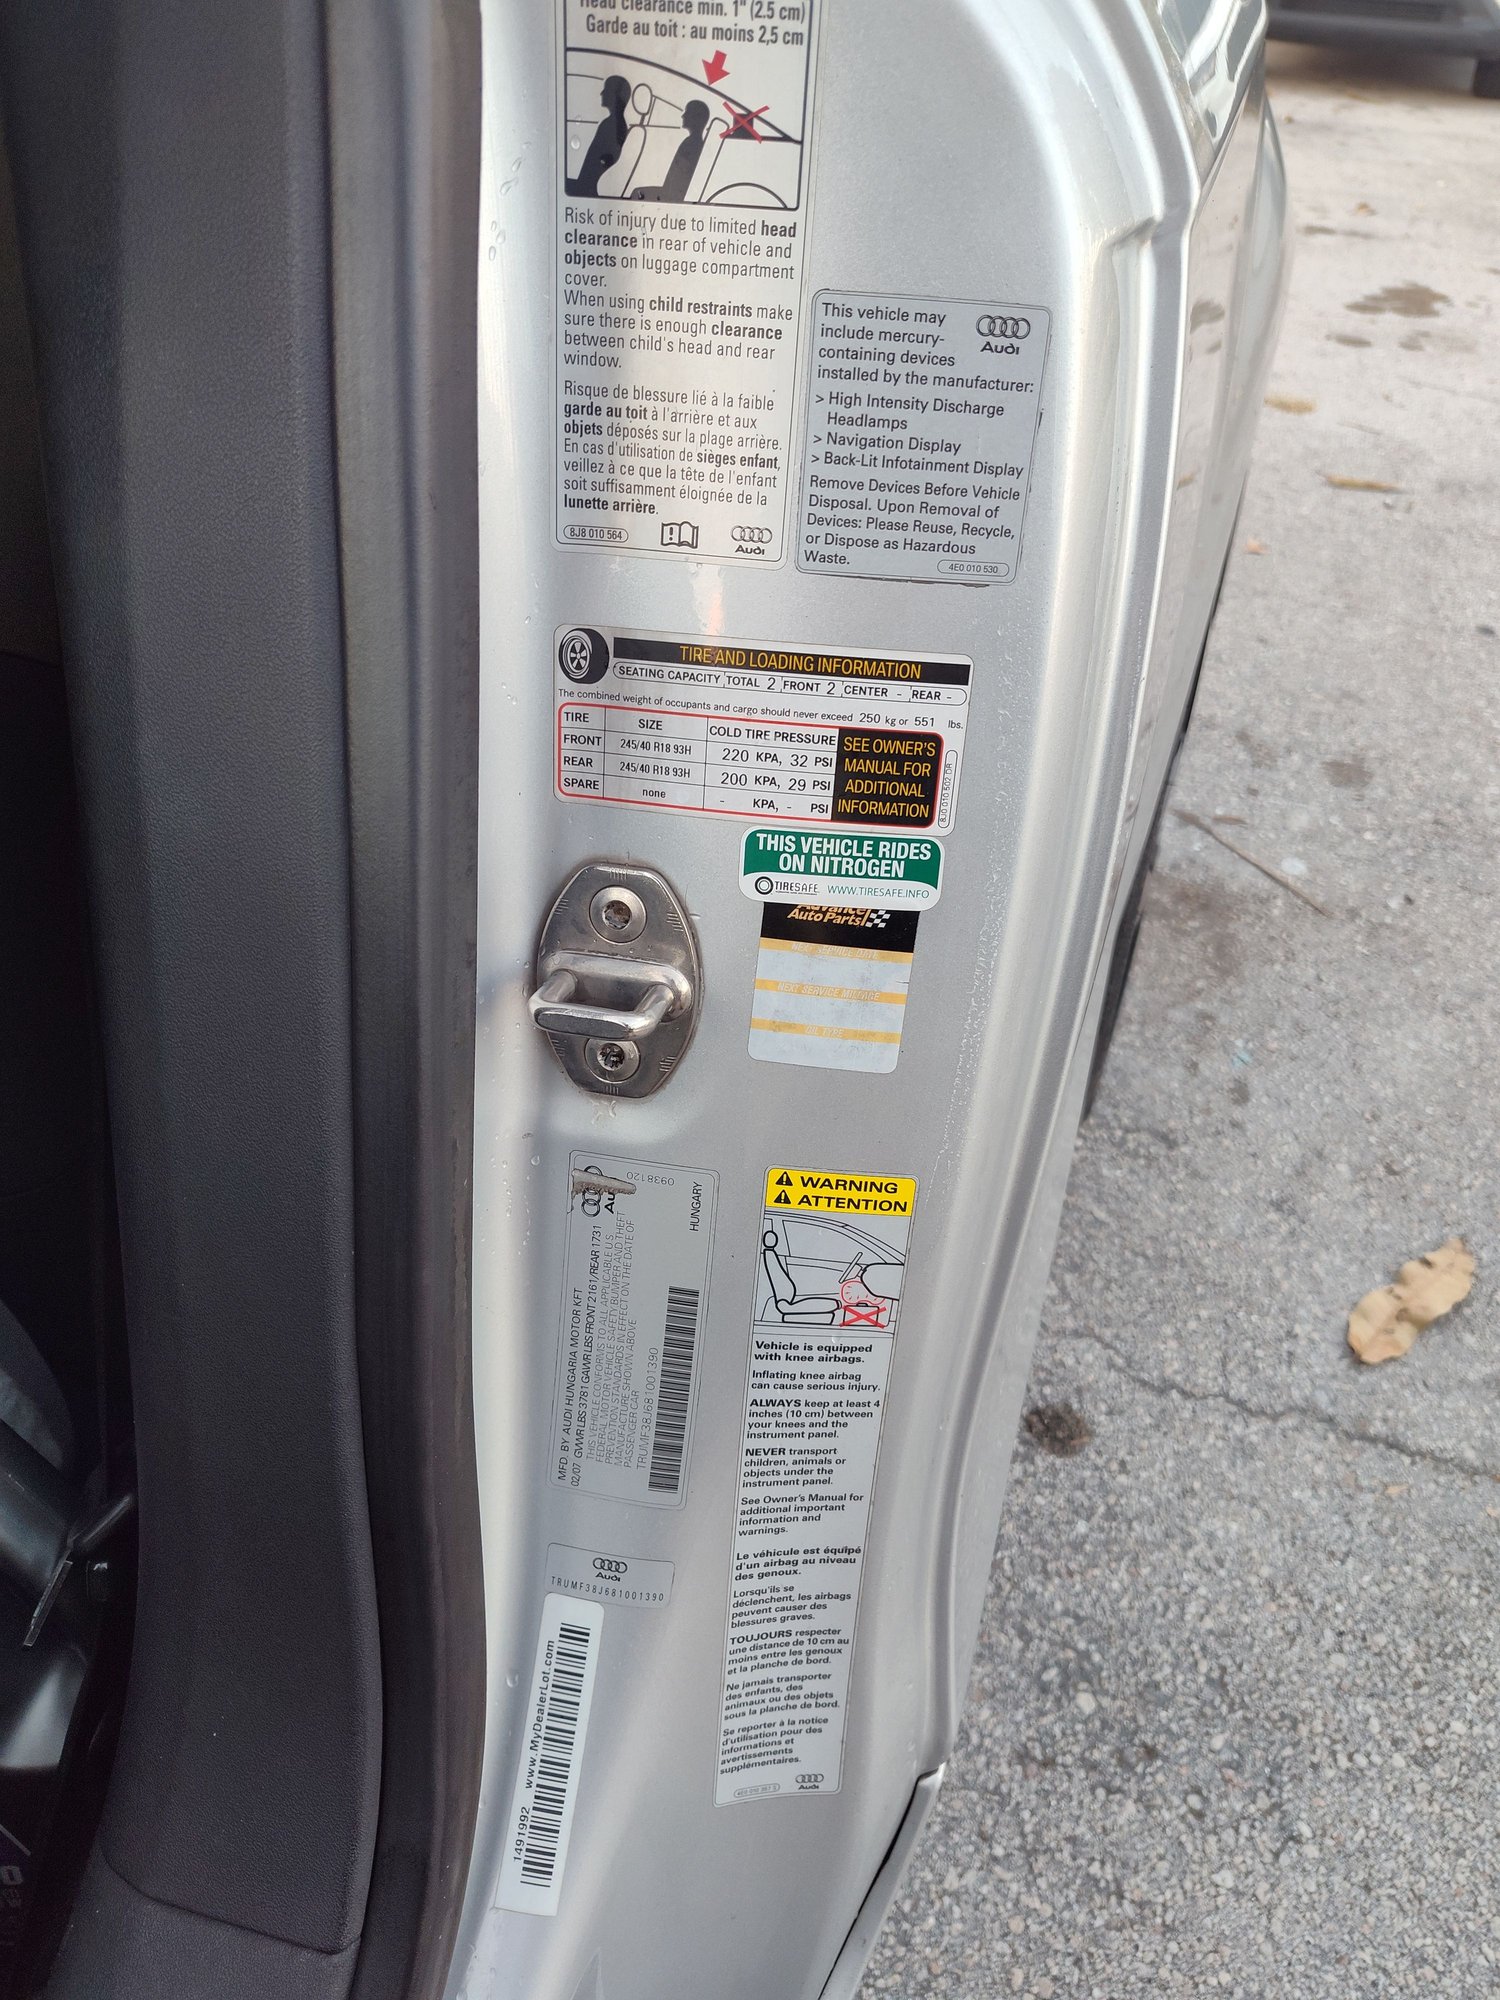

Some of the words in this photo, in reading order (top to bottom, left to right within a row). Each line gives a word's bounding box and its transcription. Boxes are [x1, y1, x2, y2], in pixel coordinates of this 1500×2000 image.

[698, 0, 727, 16] min.
[750, 0, 775, 21] (2.5
[779, 2, 805, 24] cm)
[586, 14, 628, 34] Garde
[633, 22, 650, 36] au
[654, 19, 678, 38] toit
[690, 25, 707, 39] au
[712, 23, 754, 43] moins
[758, 25, 778, 46] 2,5
[782, 31, 804, 46] cm
[565, 207, 594, 224] Risk
[599, 210, 613, 226] of
[617, 210, 656, 232] injury
[661, 213, 686, 231] due
[691, 217, 704, 232] to
[709, 216, 756, 235] limited
[761, 220, 797, 238] head
[565, 249, 617, 269] objects
[621, 256, 637, 268] on
[642, 254, 697, 276] luggage
[702, 262, 795, 280] compartment
[565, 273, 607, 287] cover.
[564, 289, 604, 307] When
[609, 294, 644, 314] using
[649, 296, 683, 312] child
[687, 301, 752, 318] restraints
[757, 304, 793, 321] make
[822, 302, 853, 318] This
[857, 306, 909, 322] vehicle
[914, 312, 946, 327] may
[821, 323, 874, 340] include
[878, 331, 944, 348] mercury-
[819, 346, 896, 366] containing
[900, 350, 955, 367] devices
[980, 341, 1020, 355] Audi
[818, 364, 879, 382] installed
[883, 369, 901, 386] by
[905, 370, 928, 385] the
[933, 375, 1034, 393] manufacturer:
[829, 391, 862, 409] High
[867, 394, 929, 414] Intensity
[933, 398, 1004, 418] Discharge
[827, 411, 907, 432] Headlamps
[827, 431, 903, 450] Navigation
[908, 437, 961, 456] Display
[564, 438, 578, 453] En
[583, 443, 604, 455] cas
[607, 441, 675, 461] d'utilisation
[679, 447, 693, 462] de
[697, 449, 736, 468] sièges
[740, 453, 780, 471] enfant,
[824, 451, 878, 468] Back-Lit
[882, 455, 970, 473] Infotainment
[973, 461, 1024, 479] Display
[564, 494, 609, 510] lunette
[613, 499, 658, 514] arrière.
[570, 527, 586, 538] 8J8
[607, 530, 623, 540] 564
[735, 545, 765, 555] Audi
[804, 550, 850, 565] Waste.
[948, 563, 965, 572] 4E0
[983, 565, 999, 574] 530
[680, 646, 711, 663] TIRE
[715, 650, 746, 666] AND
[750, 652, 814, 672] LOADING
[818, 657, 921, 679] INFORMATION
[619, 665, 664, 679] SEATING
[668, 670, 721, 684] CAPACITY
[726, 675, 760, 687] TOTAL
[767, 677, 776, 690] 2
[783, 680, 821, 692] FRONT
[826, 682, 836, 695] 2
[844, 685, 888, 697] CENTER
[912, 690, 941, 700] REAR
[564, 712, 589, 723] TIRE
[638, 719, 662, 730] SIZE
[709, 726, 742, 738] COLD
[745, 729, 770, 740] TIRE
[774, 731, 836, 746] PRESSURE
[859, 713, 881, 724] 250
[885, 716, 896, 727] kg
[914, 716, 934, 727] 551
[948, 720, 963, 729] lbs.
[564, 734, 602, 746] FRONT
[620, 738, 651, 751] 245/40
[654, 741, 671, 753] R18
[673, 744, 691, 755] 93H
[722, 748, 749, 762] 220
[756, 752, 782, 766] KPA,
[790, 754, 808, 767] 32
[814, 757, 833, 767] PSI
[844, 737, 870, 752] SEE
[873, 739, 936, 756] OWNER'S
[844, 758, 900, 775] MANUAL
[903, 762, 931, 777] FOR
[845, 779, 925, 797] ADDITIONAL
[838, 799, 929, 818] INFORMATION
[756, 833, 796, 852] THIS
[801, 837, 873, 857] VEHICLE
[878, 841, 931, 860] RIDES
[779, 853, 805, 872] ON
[811, 855, 905, 878] NITROGEN
[775, 881, 818, 893] TIRESAFE
[827, 884, 930, 899] WWW.TIRESAFE.INFO
[787, 908, 823, 922] Auto
[823, 912, 862, 927] Parts
[626, 1171, 675, 1186] 0938120
[800, 1176, 898, 1194] WARNING
[689, 1181, 702, 1231] HUNGARY
[797, 1194, 908, 1212] ATTENTION
[573, 1288, 582, 1307] KFT
[570, 1309, 581, 1348] MOTOR
[755, 1340, 799, 1351] Vehicle
[803, 1343, 813, 1351] is
[817, 1344, 872, 1354] equipped
[565, 1351, 578, 1406] HUNGARIA
[750, 1399, 801, 1407] ALWAYS
[804, 1399, 830, 1409] keep
[846, 1400, 871, 1408] least
[562, 1408, 573, 1436] AUDI
[560, 1437, 570, 1452] BY
[745, 1448, 786, 1456] NEVER
[789, 1448, 837, 1457] transport
[558, 1456, 568, 1480] MFD.
[570, 1462, 581, 1487] 02/07
[741, 1497, 760, 1505] See
[763, 1494, 805, 1504] Owner's
[808, 1493, 847, 1502] Manual
[849, 1493, 864, 1501] for
[595, 1572, 621, 1582] Audi
[730, 1629, 792, 1645] TOUJOURS
[795, 1628, 841, 1637] respecter
[525, 1640, 554, 1789] www.MyDealerLot.com
[513, 1806, 531, 1863] 1491992
